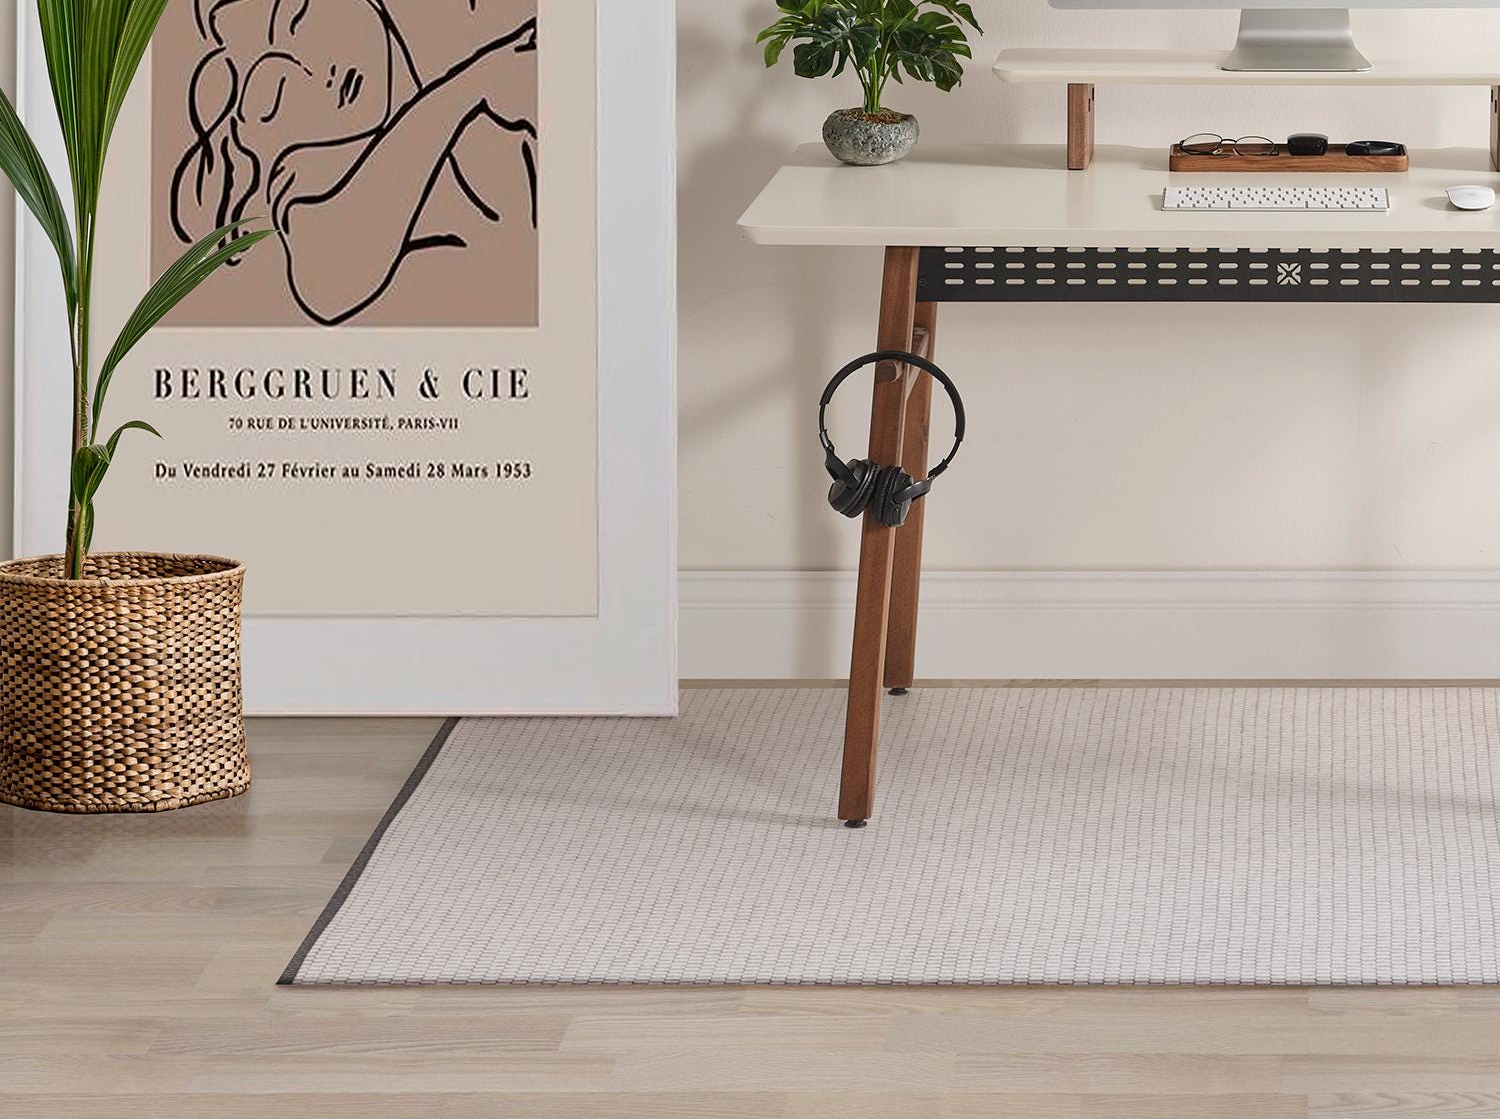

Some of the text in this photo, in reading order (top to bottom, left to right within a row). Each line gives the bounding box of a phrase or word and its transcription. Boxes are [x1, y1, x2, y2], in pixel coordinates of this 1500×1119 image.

[154, 368, 529, 399] BERGGRUEN & CIE
[228, 413, 459, 432] 70 RUE DE L'UNIVERSITÉ, PARIS-VII
[155, 461, 532, 479] Du Vendredi 27 Février au Samedi 28 Mars 1953
